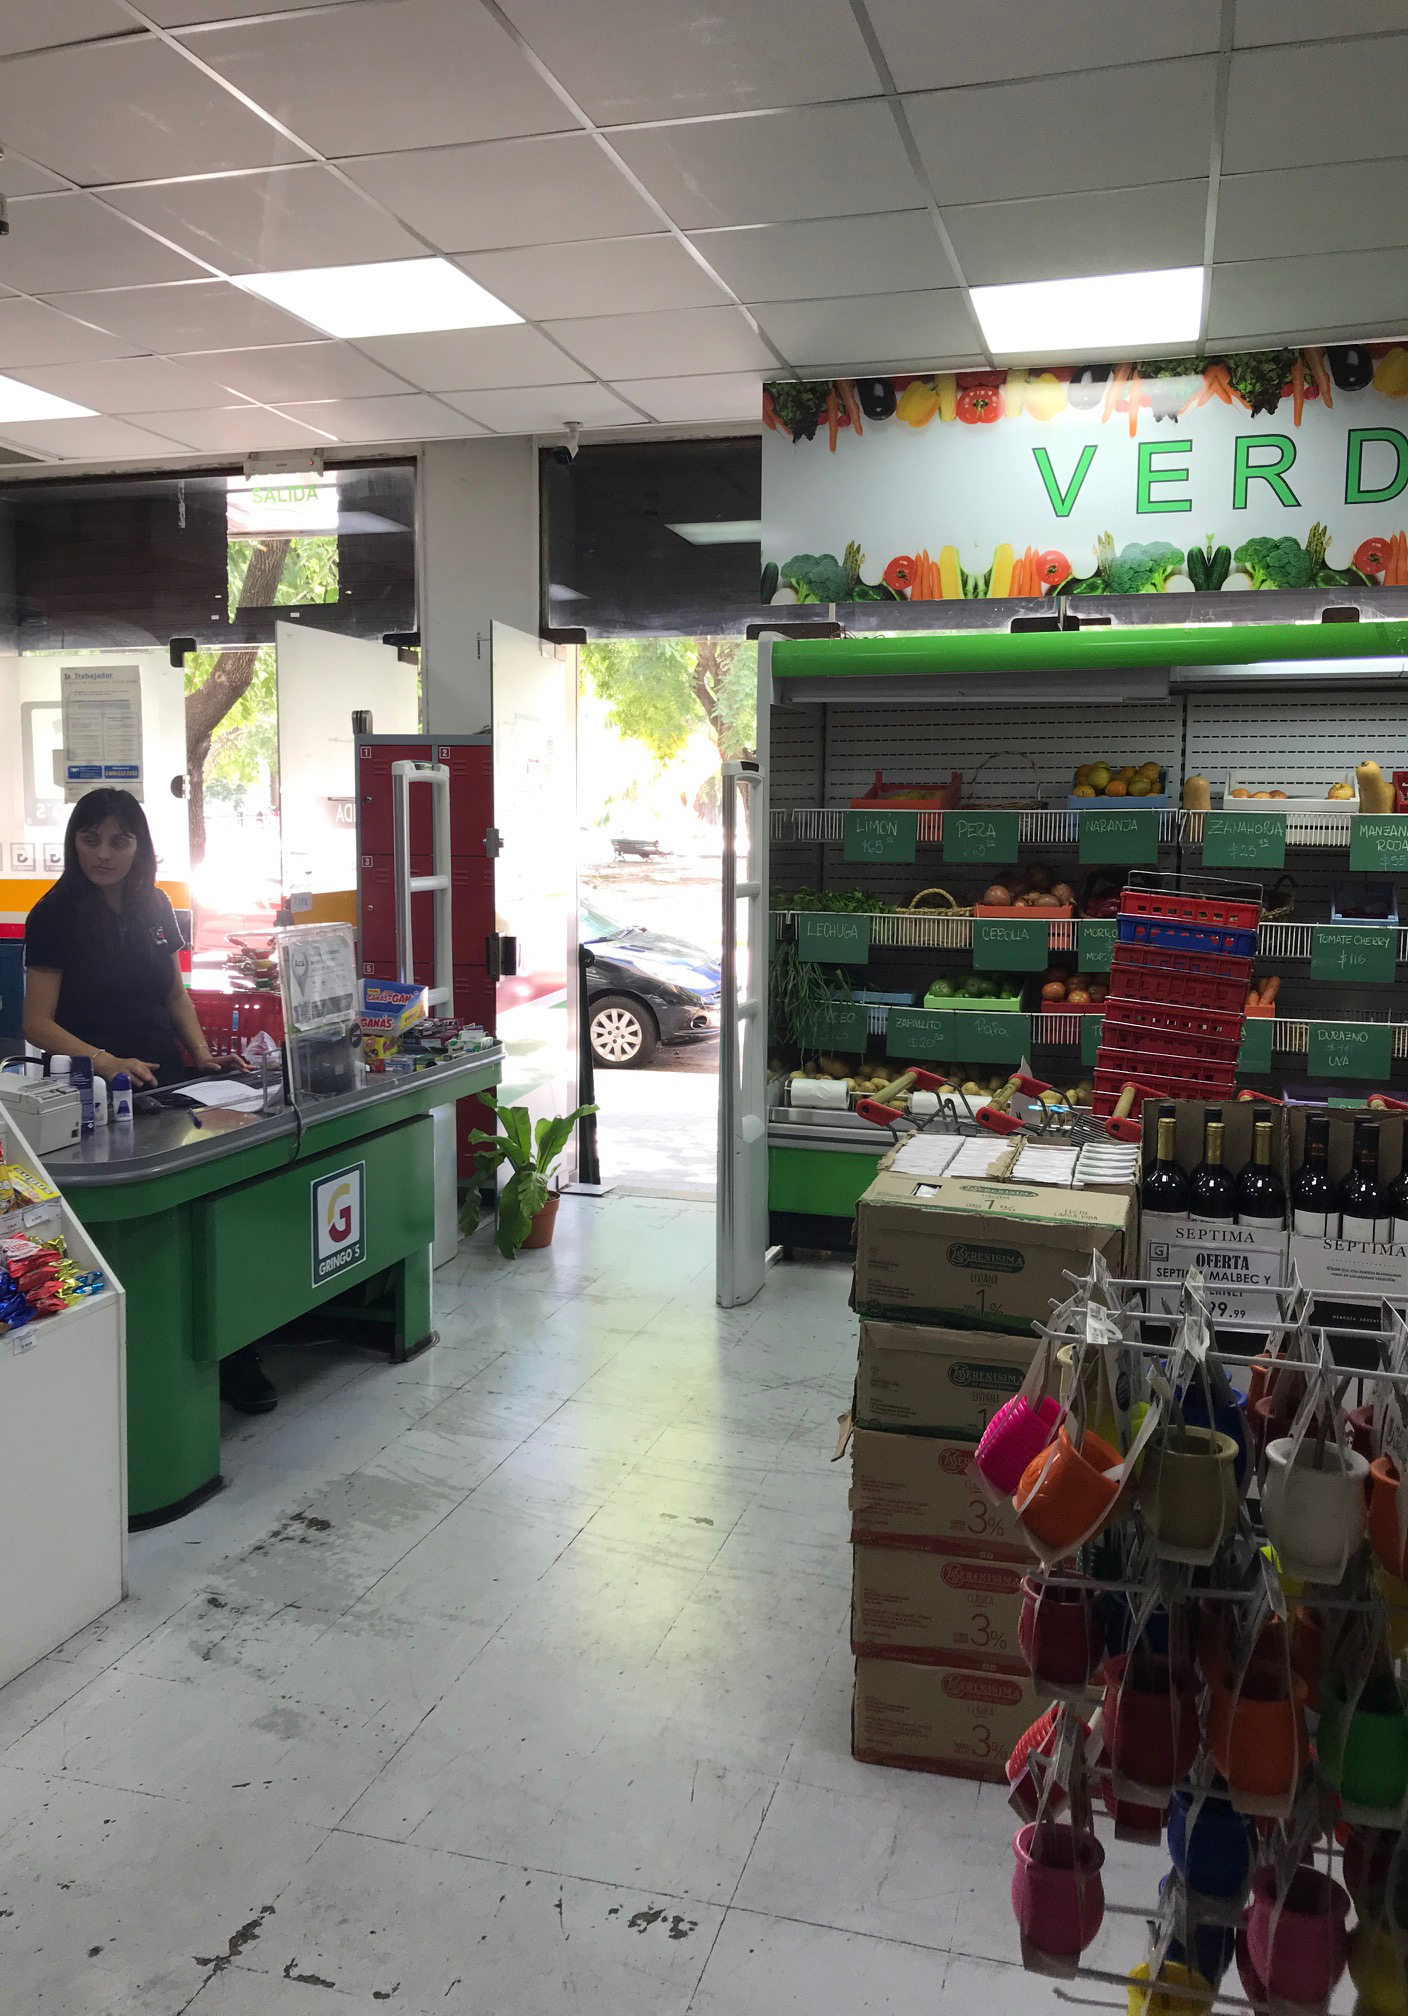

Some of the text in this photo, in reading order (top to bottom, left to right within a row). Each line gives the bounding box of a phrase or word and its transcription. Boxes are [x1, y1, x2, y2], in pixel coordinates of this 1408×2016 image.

[1031, 427, 1408, 518] VERD
[252, 485, 319, 503] SALIDA
[956, 819, 996, 838] PERA
[1085, 818, 1139, 833] NARANJA
[1207, 819, 1284, 837] ZANAHORIA
[1359, 825, 1408, 838] MANZAN
[1375, 839, 1408, 852] ROJA
[807, 920, 859, 940] LECHUGA
[981, 926, 1030, 942] CEBOLLA
[1316, 933, 1390, 949] TOMATE CHERRY
[895, 1017, 942, 1035] ZAPALLITO
[1317, 1029, 1369, 1043] DURAZNO
[1328, 1056, 1349, 1067] UVA
[1175, 1227, 1255, 1243] SEPTIMA
[1323, 1238, 1408, 1258] SEPTIMA
[1195, 1252, 1250, 1271] OFERTA
[970, 1272, 999, 1286] LIVIANA
[1156, 1267, 1271, 1285] SEPTI MALBEC Y
